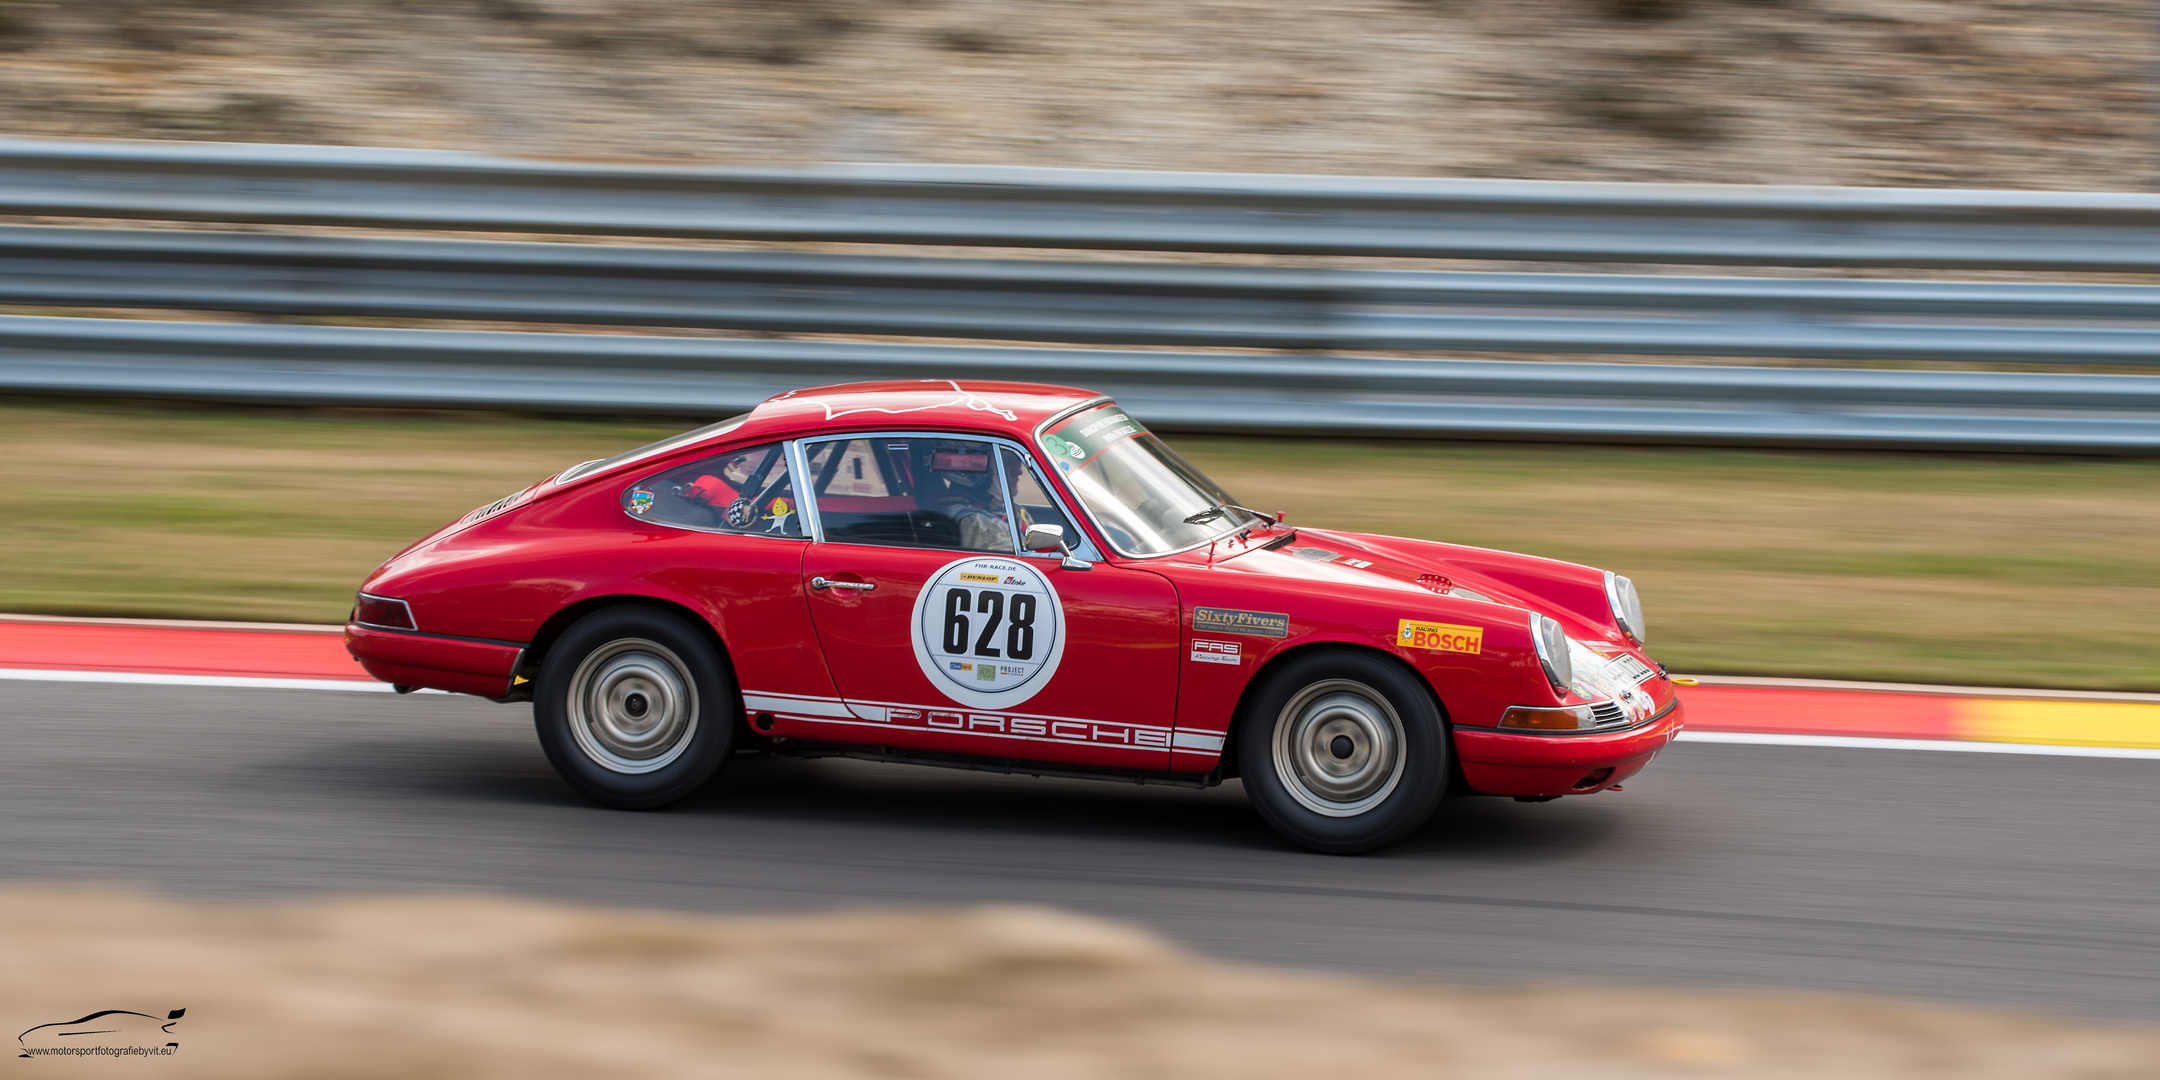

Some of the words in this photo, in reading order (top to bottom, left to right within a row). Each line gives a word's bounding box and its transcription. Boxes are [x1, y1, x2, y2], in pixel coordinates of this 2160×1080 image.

[974, 563, 1017, 572] FHR-RACE.DE
[966, 574, 998, 582] DUNLOP
[943, 588, 1037, 660] 628
[1196, 609, 1286, 627] SixtyFivers
[1194, 641, 1239, 654] FAS
[1413, 631, 1480, 653] BOSCH
[1195, 654, 1219, 662] Racing
[1000, 665, 1025, 674] PROJECT
[886, 707, 1166, 747] PORSCHE
